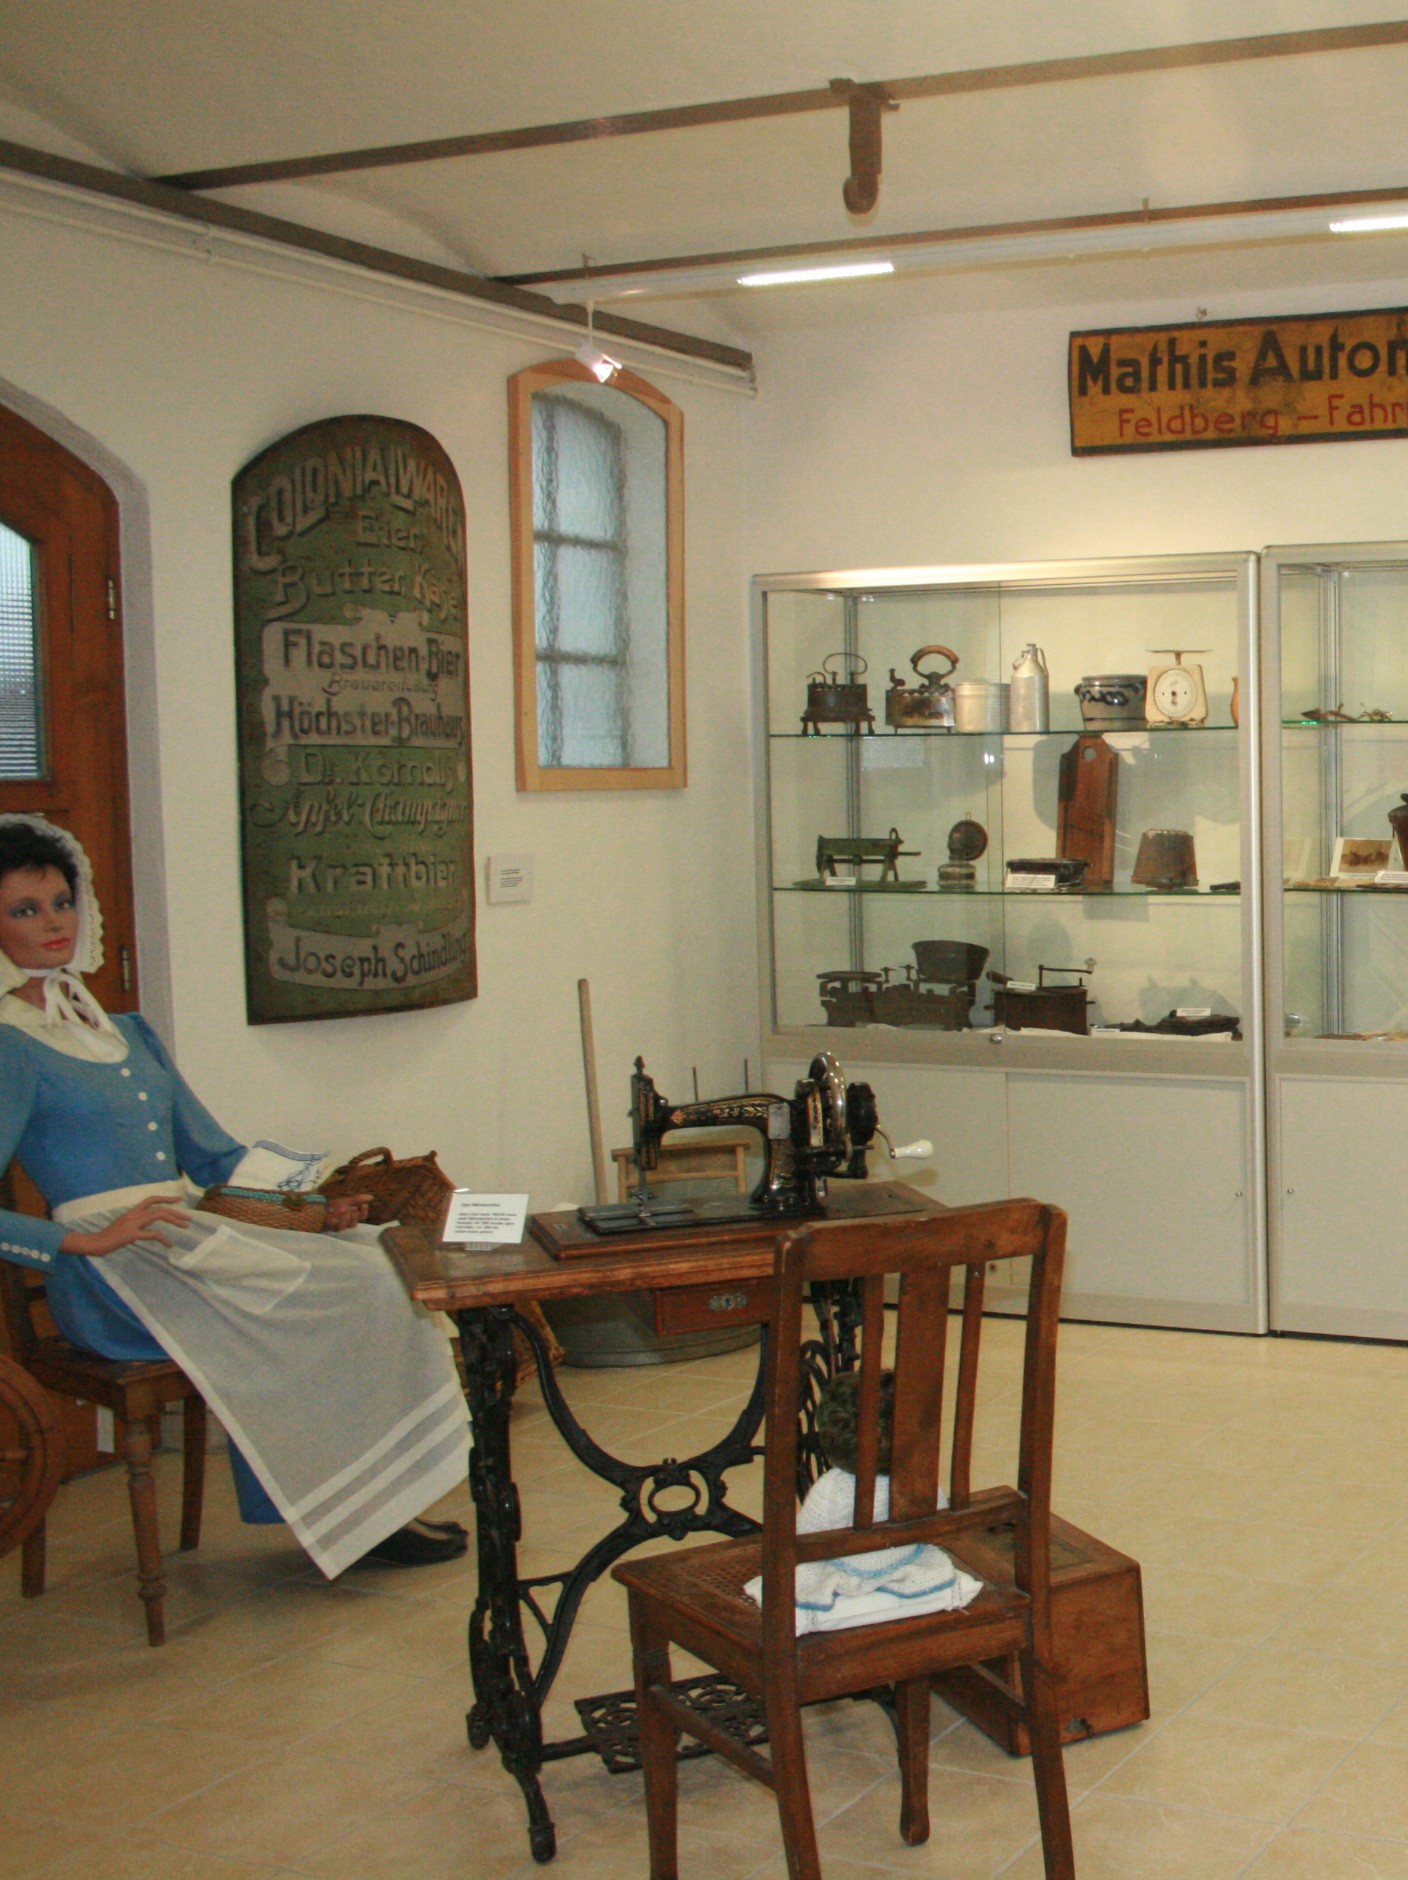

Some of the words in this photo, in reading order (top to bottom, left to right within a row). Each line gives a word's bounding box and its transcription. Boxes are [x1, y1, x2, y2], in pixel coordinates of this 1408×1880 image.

[1077, 337, 1238, 397] Mathis
[1117, 403, 1279, 439] Feldberg
[287, 852, 456, 895] Kraftbier
[278, 935, 388, 987] Joseph
